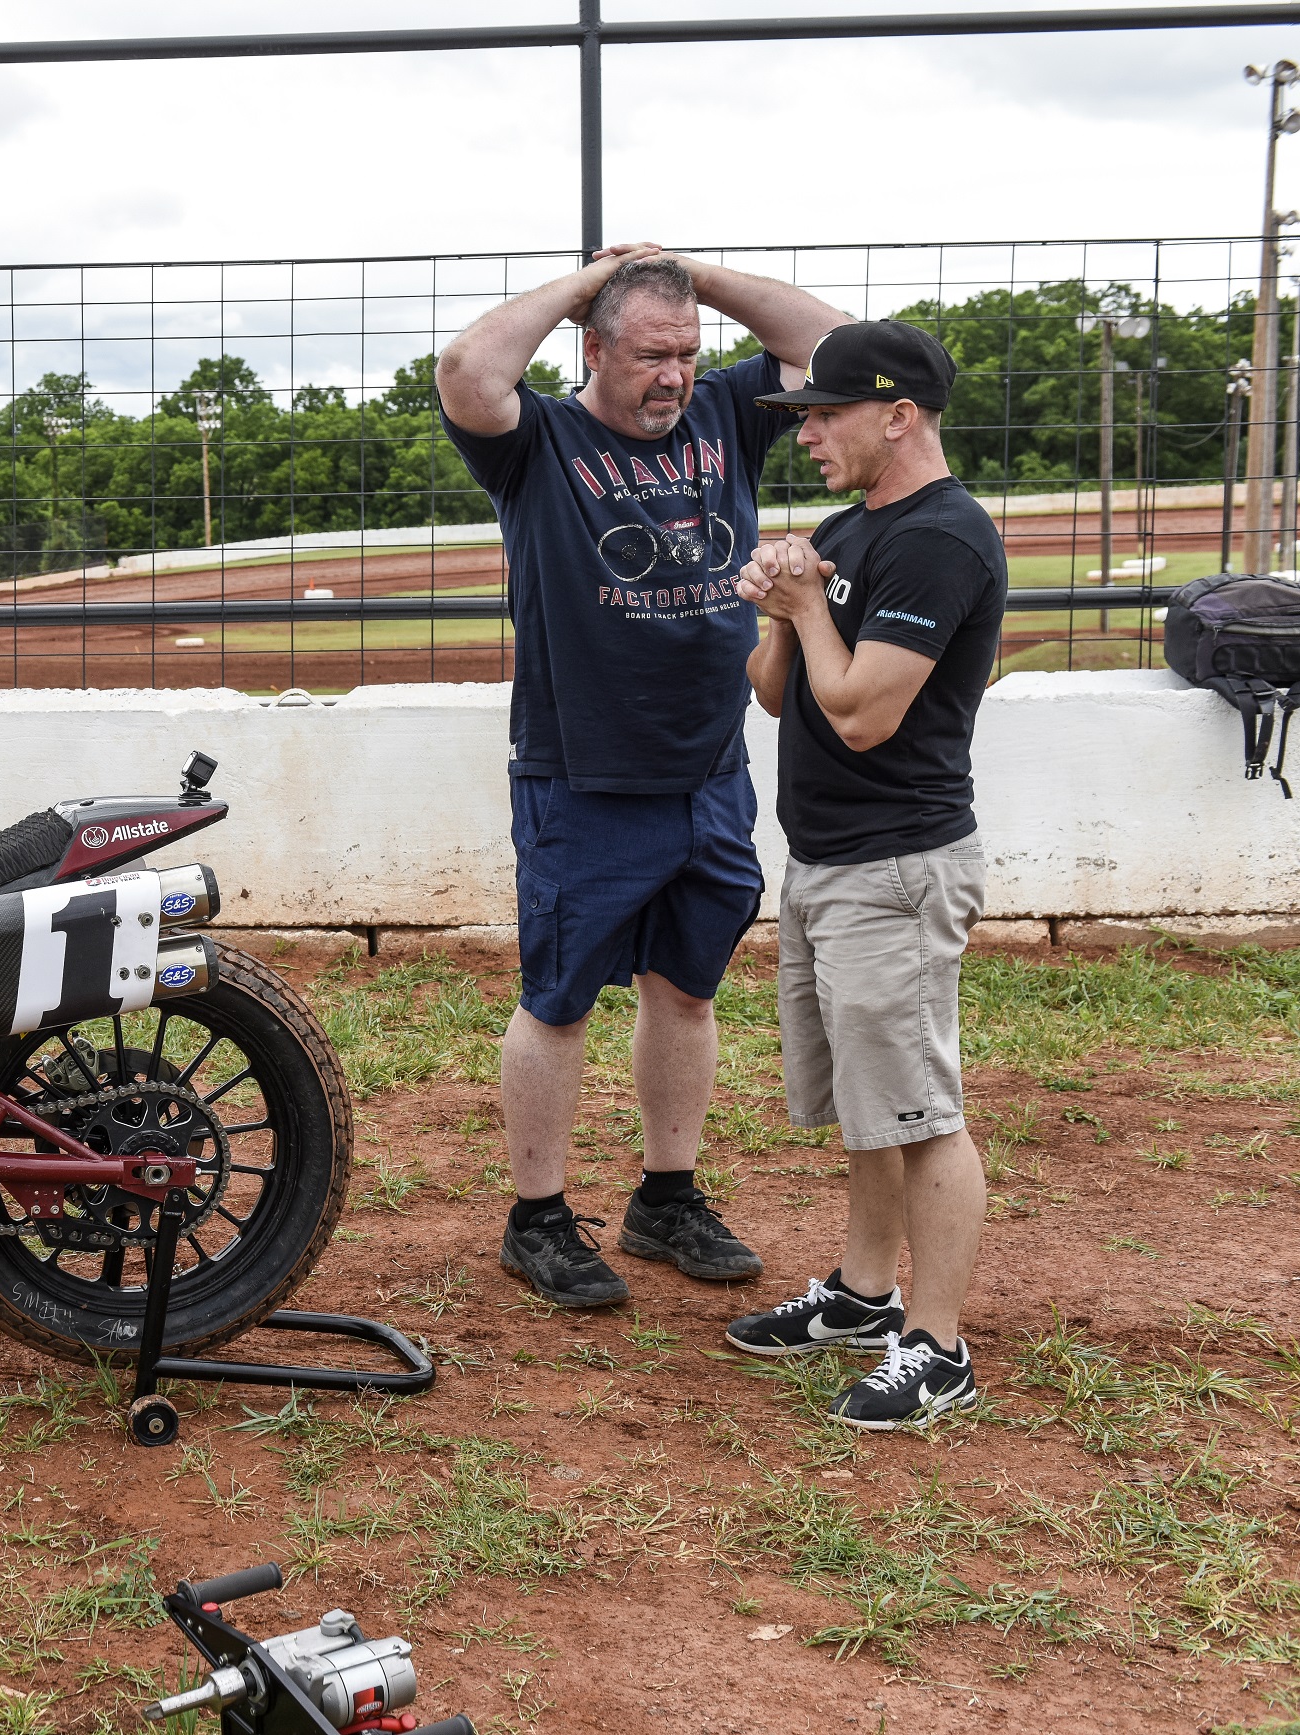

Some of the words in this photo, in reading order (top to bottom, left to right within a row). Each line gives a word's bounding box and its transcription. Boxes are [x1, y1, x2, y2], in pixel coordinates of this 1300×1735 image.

[613, 485, 680, 502] MORCYCLE
[599, 583, 704, 608] FACTORY
[111, 819, 169, 842] Allstate
[164, 897, 190, 911] S&S
[37, 889, 124, 1030] 1
[164, 969, 190, 983] S&S
